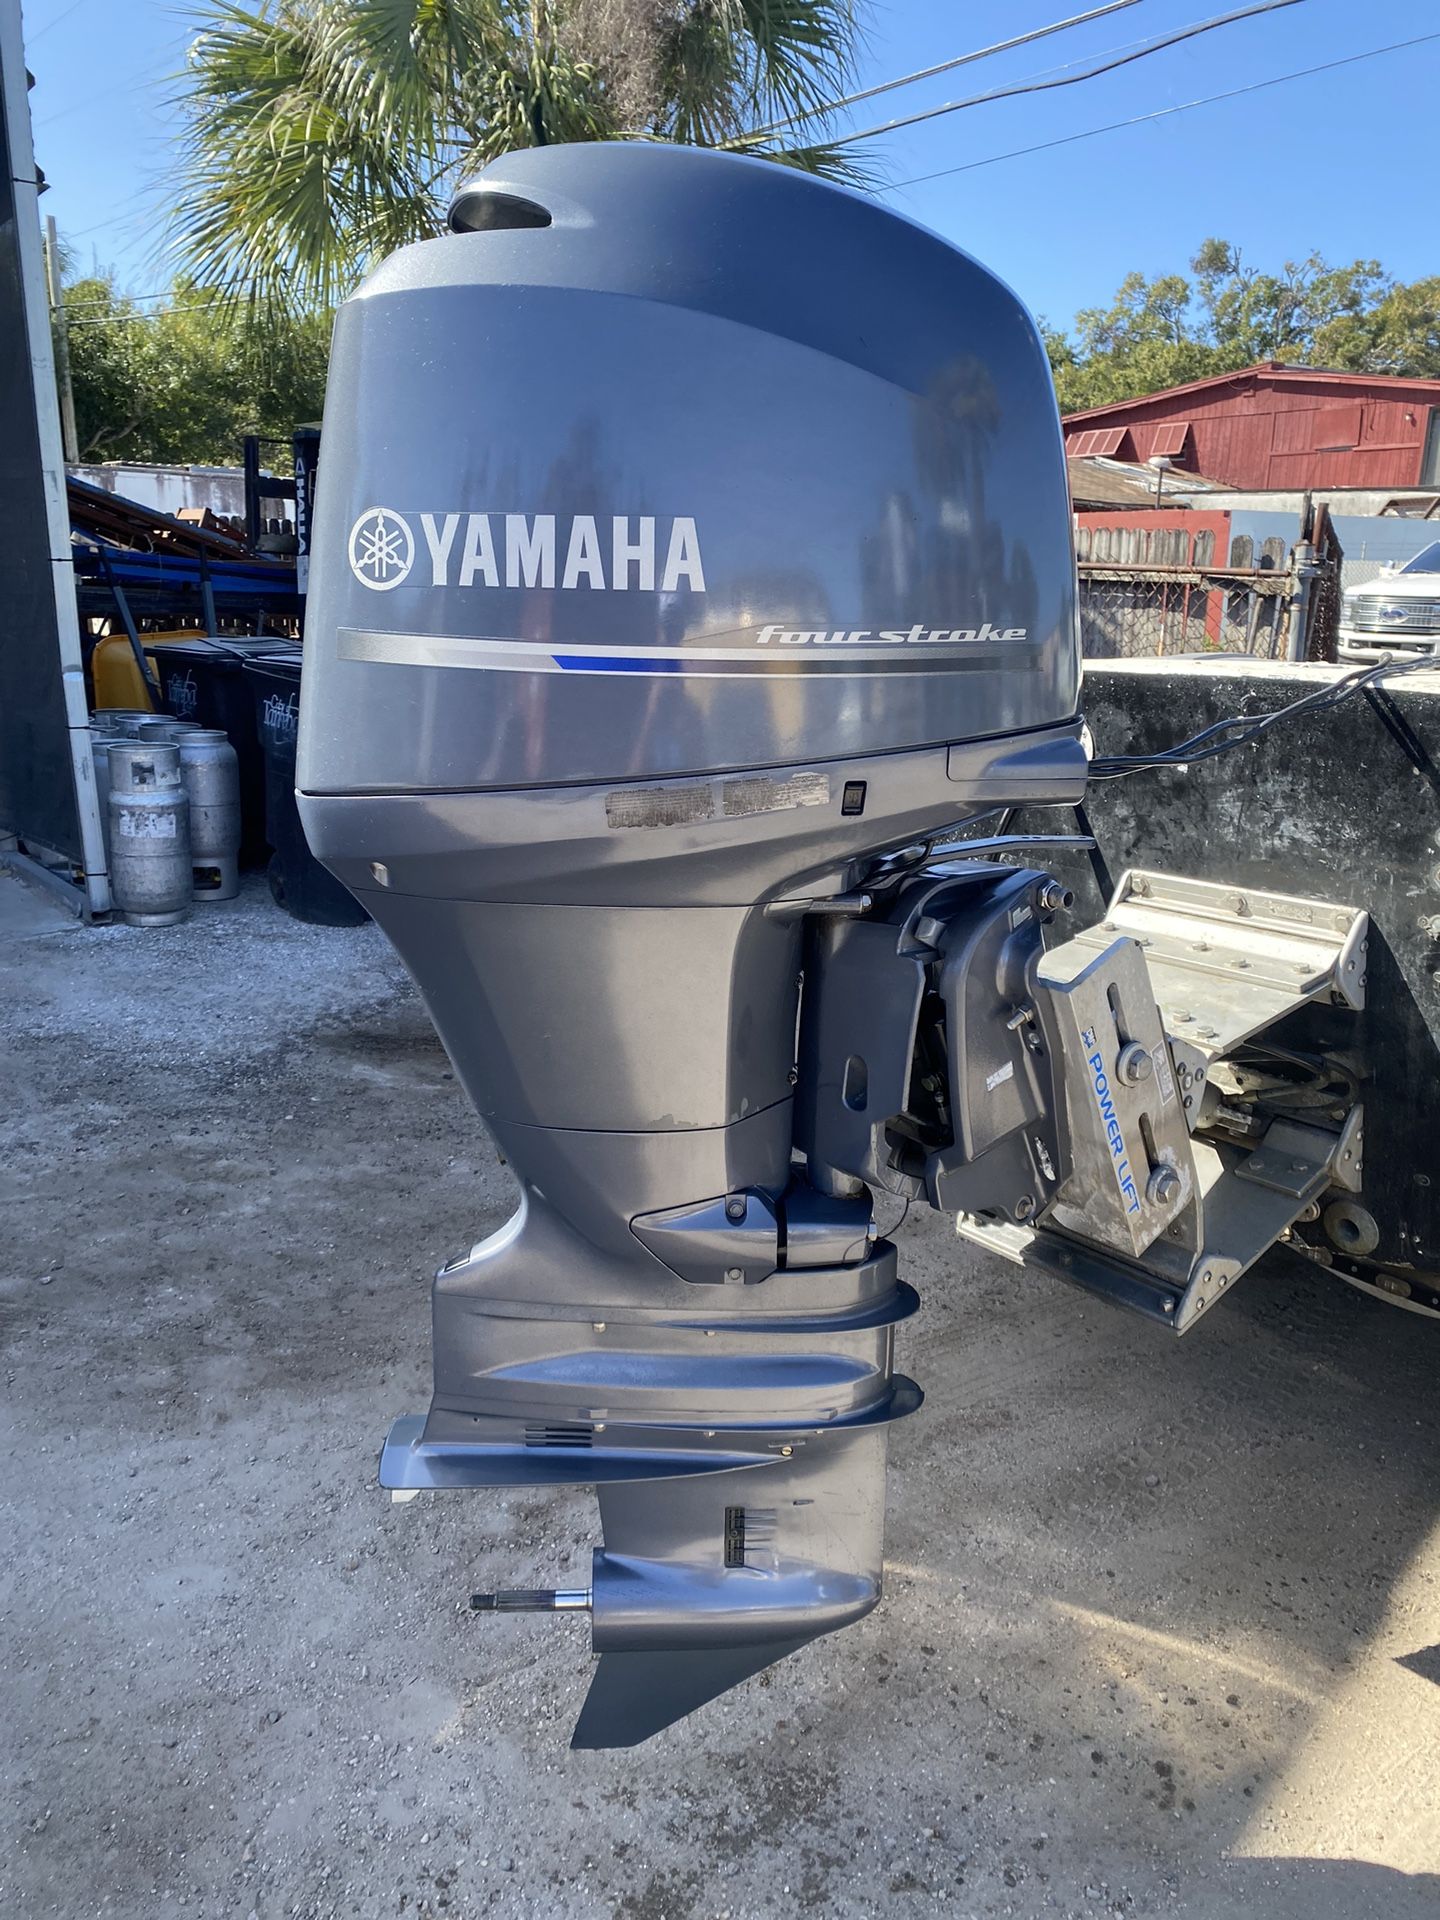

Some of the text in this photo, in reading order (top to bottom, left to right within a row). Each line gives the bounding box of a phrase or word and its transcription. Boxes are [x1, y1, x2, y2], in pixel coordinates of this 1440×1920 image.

[420, 513, 706, 592] YAMAHA
[1088, 1051, 1124, 1159] POWER
[1117, 1159, 1140, 1214] LIFT
